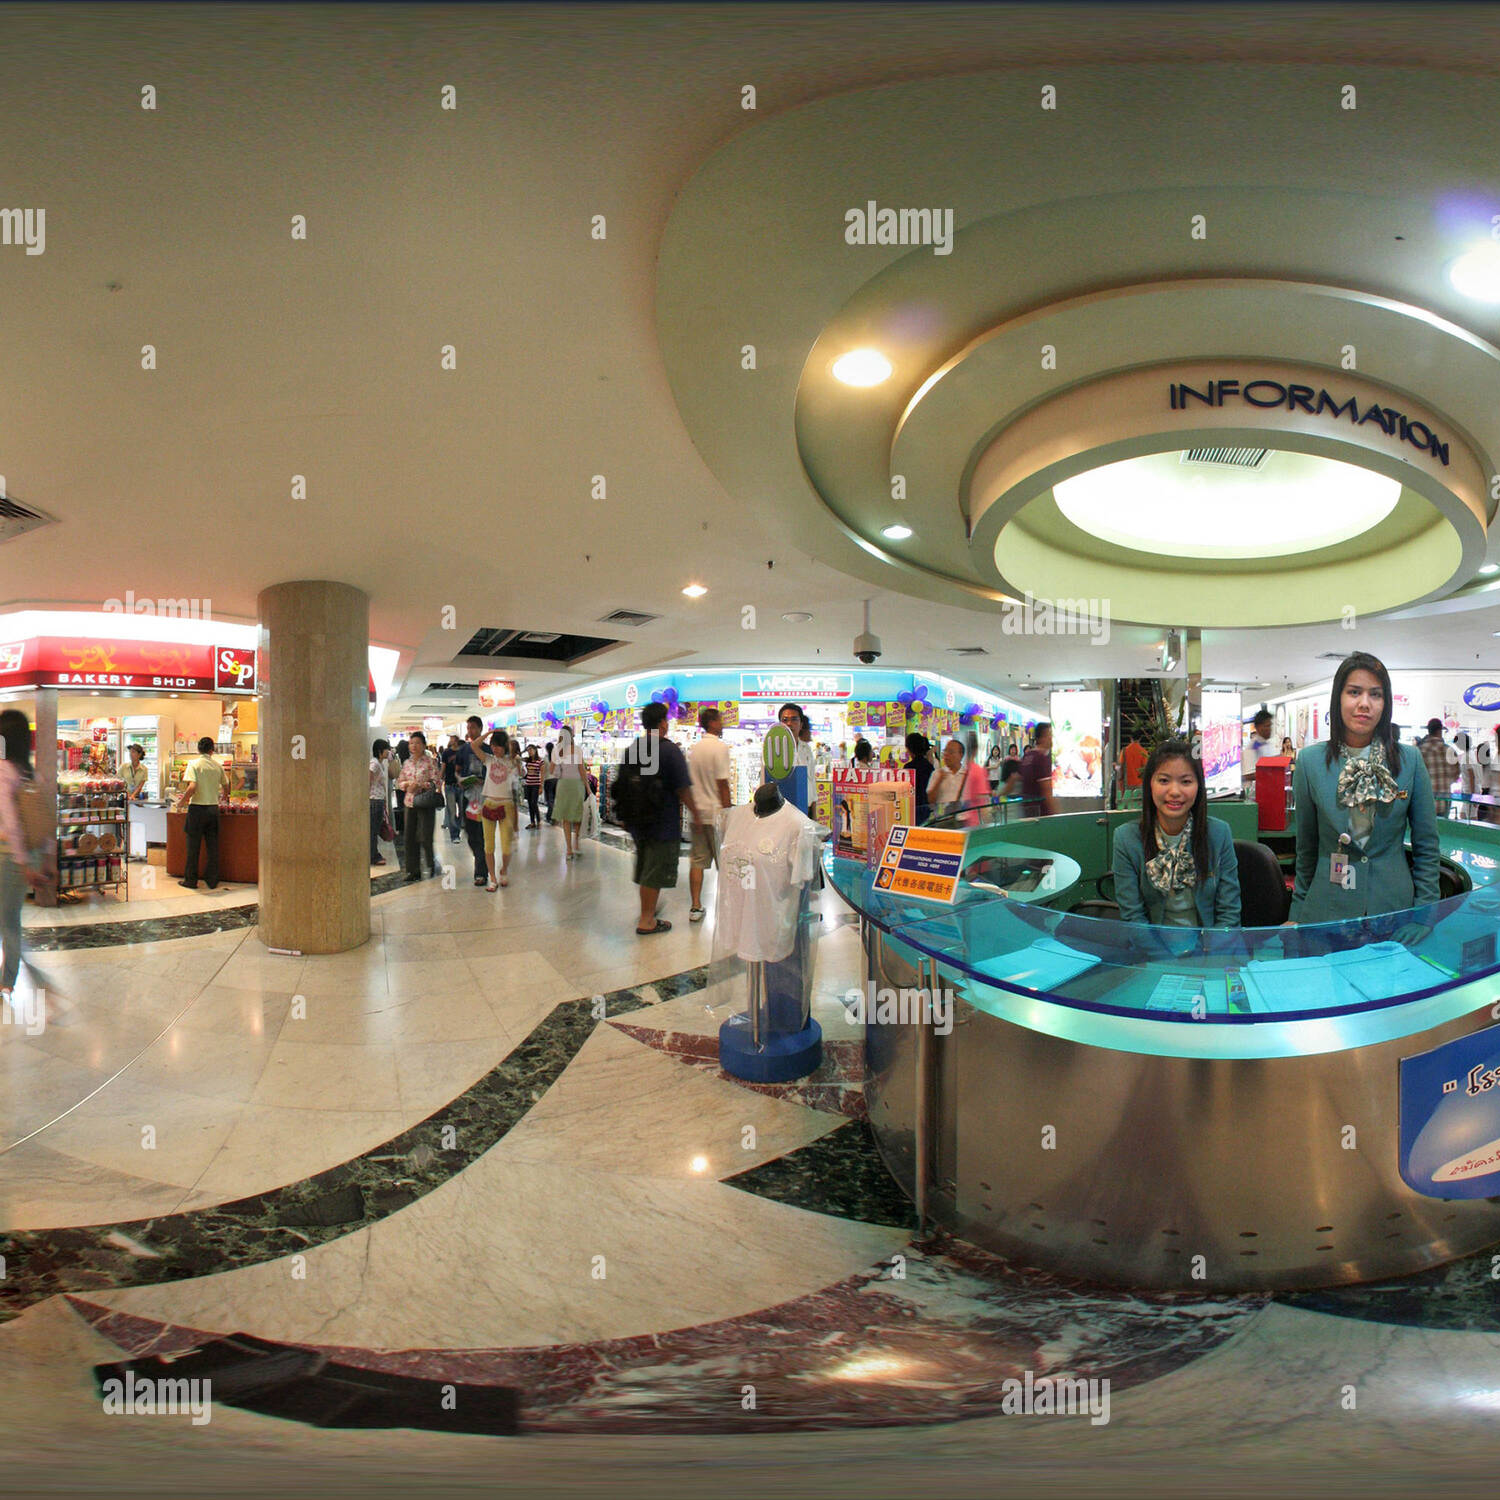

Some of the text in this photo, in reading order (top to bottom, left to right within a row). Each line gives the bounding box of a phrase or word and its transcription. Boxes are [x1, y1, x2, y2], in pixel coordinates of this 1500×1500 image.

[1169, 380, 1450, 466] INFORMATION
[58, 673, 196, 687] BAKERY SHOP
[219, 650, 253, 686] S&P
[835, 768, 910, 784] TATTOO
